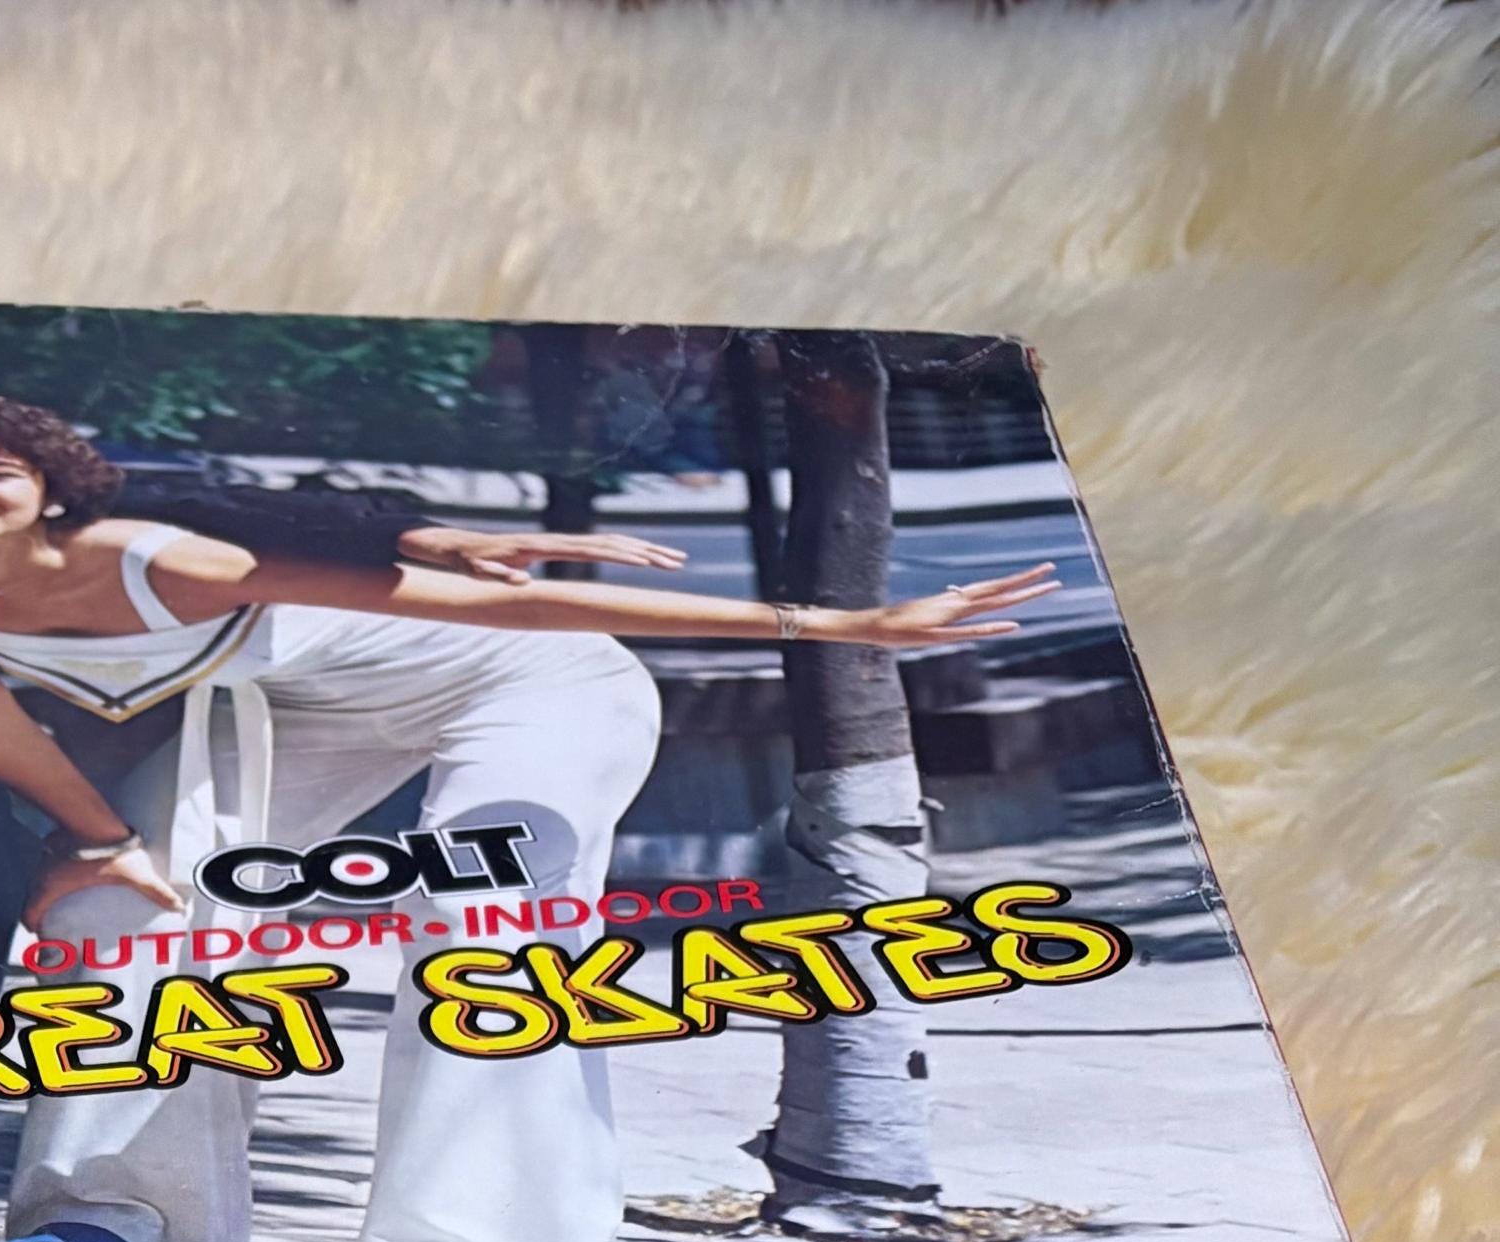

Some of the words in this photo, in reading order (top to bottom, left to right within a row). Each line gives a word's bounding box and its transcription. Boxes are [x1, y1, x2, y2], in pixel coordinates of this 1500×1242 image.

[197, 820, 536, 911] COLT
[23, 910, 412, 977] OUTDOOR
[464, 878, 763, 934] INDOOR
[416, 884, 1134, 1058] SKATES
